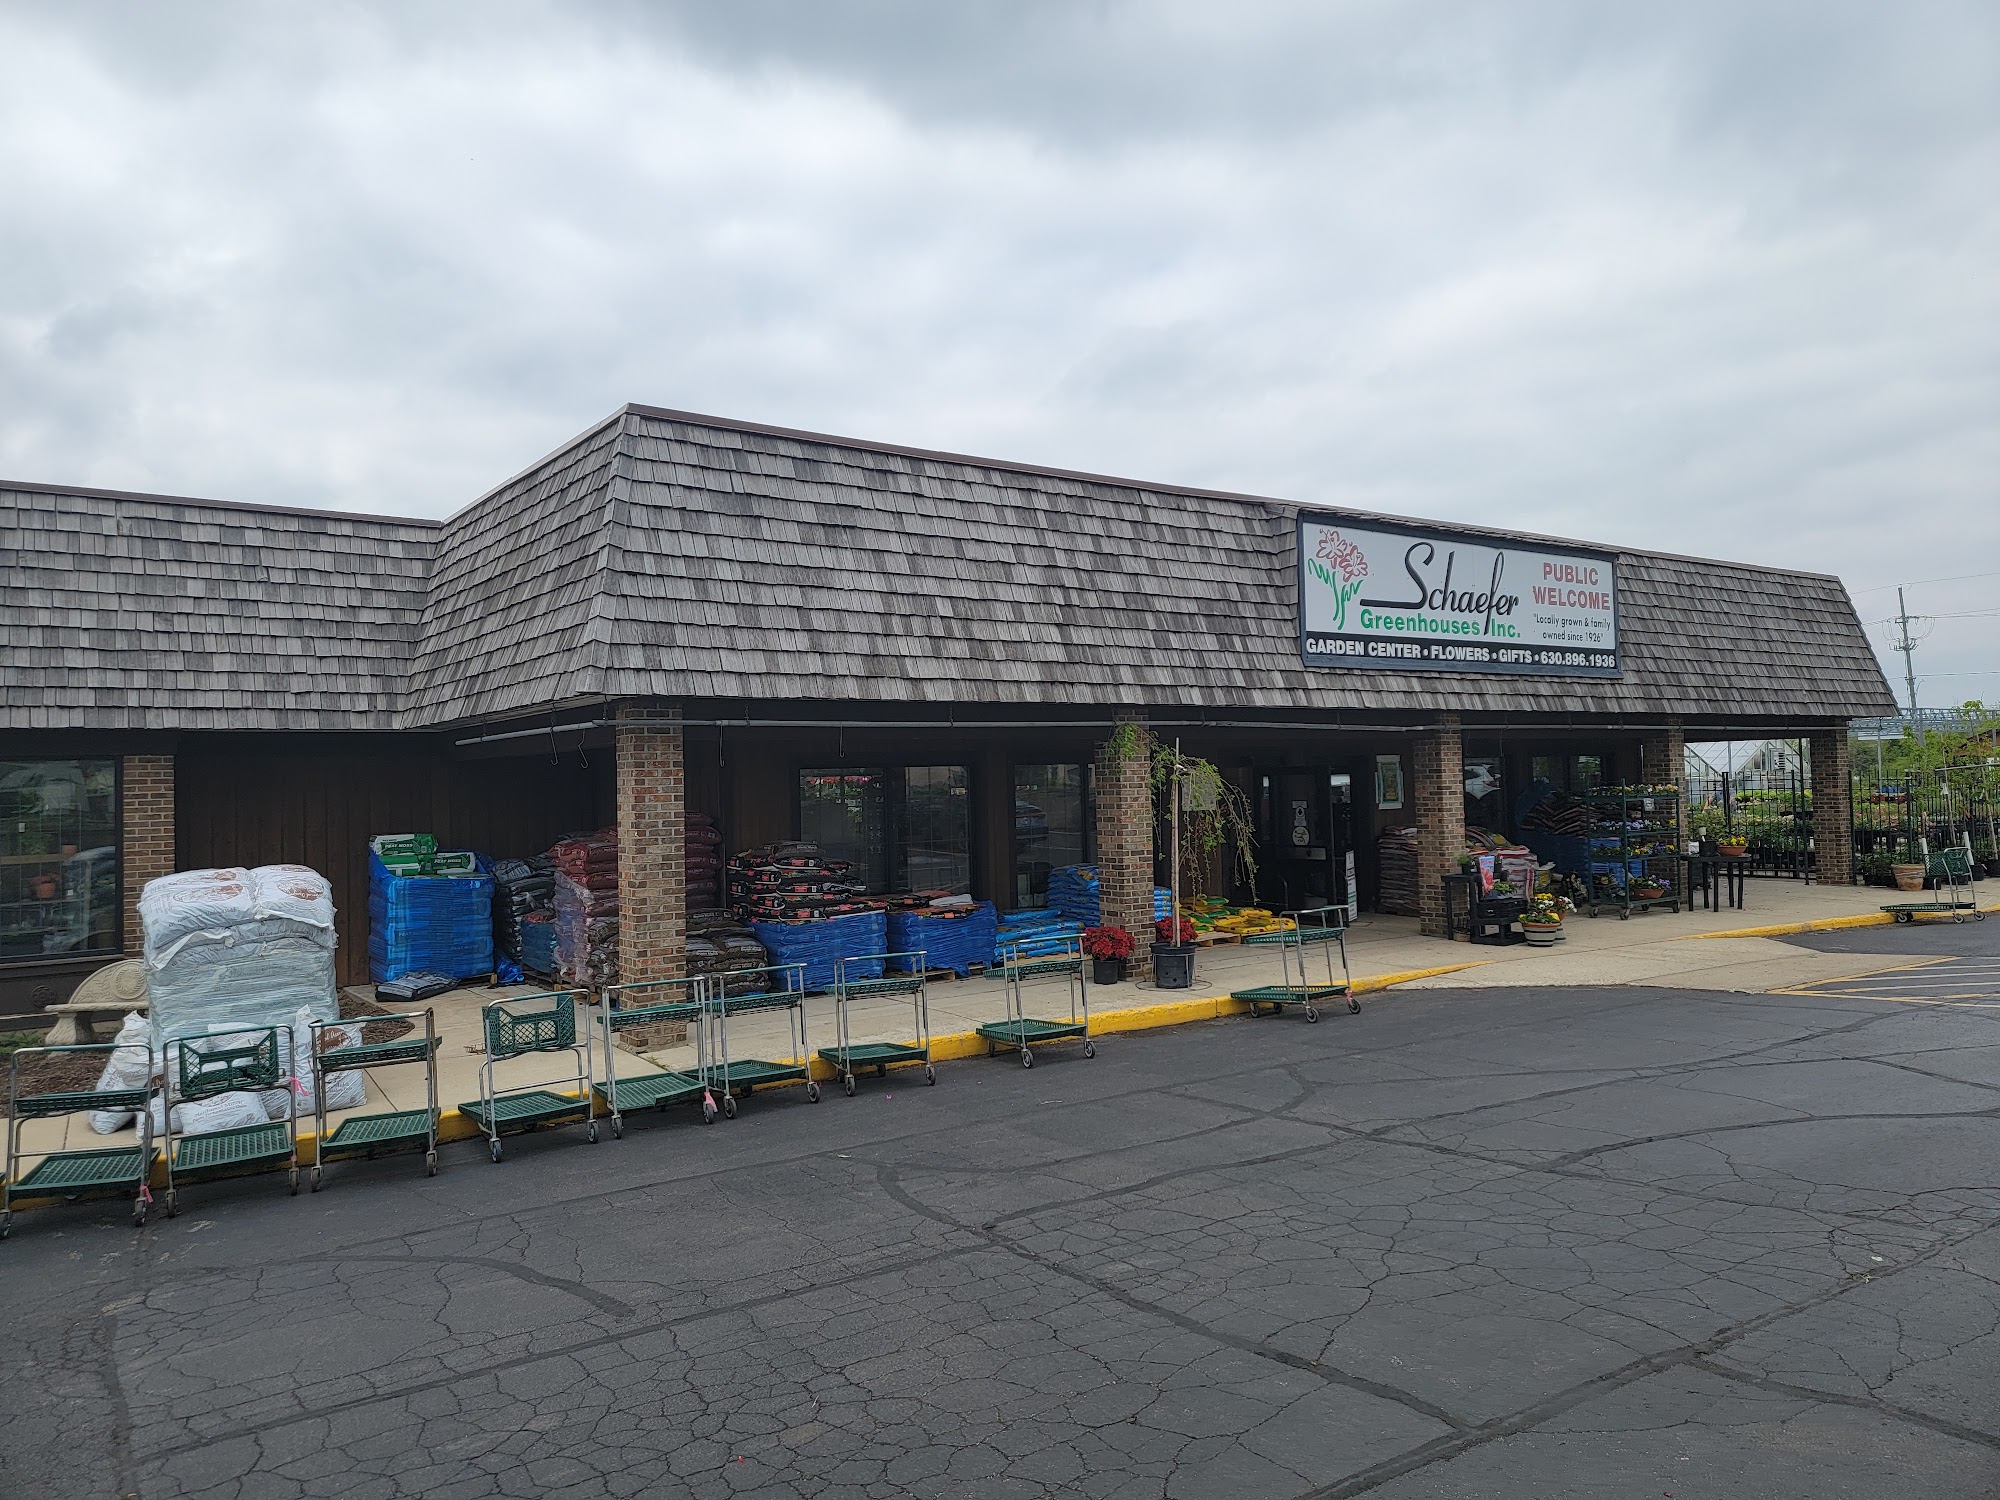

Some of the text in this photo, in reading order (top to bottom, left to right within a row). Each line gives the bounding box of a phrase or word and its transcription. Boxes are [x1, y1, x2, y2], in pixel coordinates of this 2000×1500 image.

[1543, 562, 1599, 586] PUBLIC
[1360, 542, 1519, 635] Schaefer
[1532, 586, 1611, 611] WELCOME
[1360, 608, 1521, 638] Greenhouses Inc.
[1561, 617, 1583, 628] grown
[1584, 616, 1590, 628] &
[1591, 616, 1611, 632] family
[1542, 630, 1566, 641] owned
[1567, 630, 1584, 642] since
[1306, 638, 1616, 668] GARDEN CENTER FLOWERS GIFTS 630.896.1936
